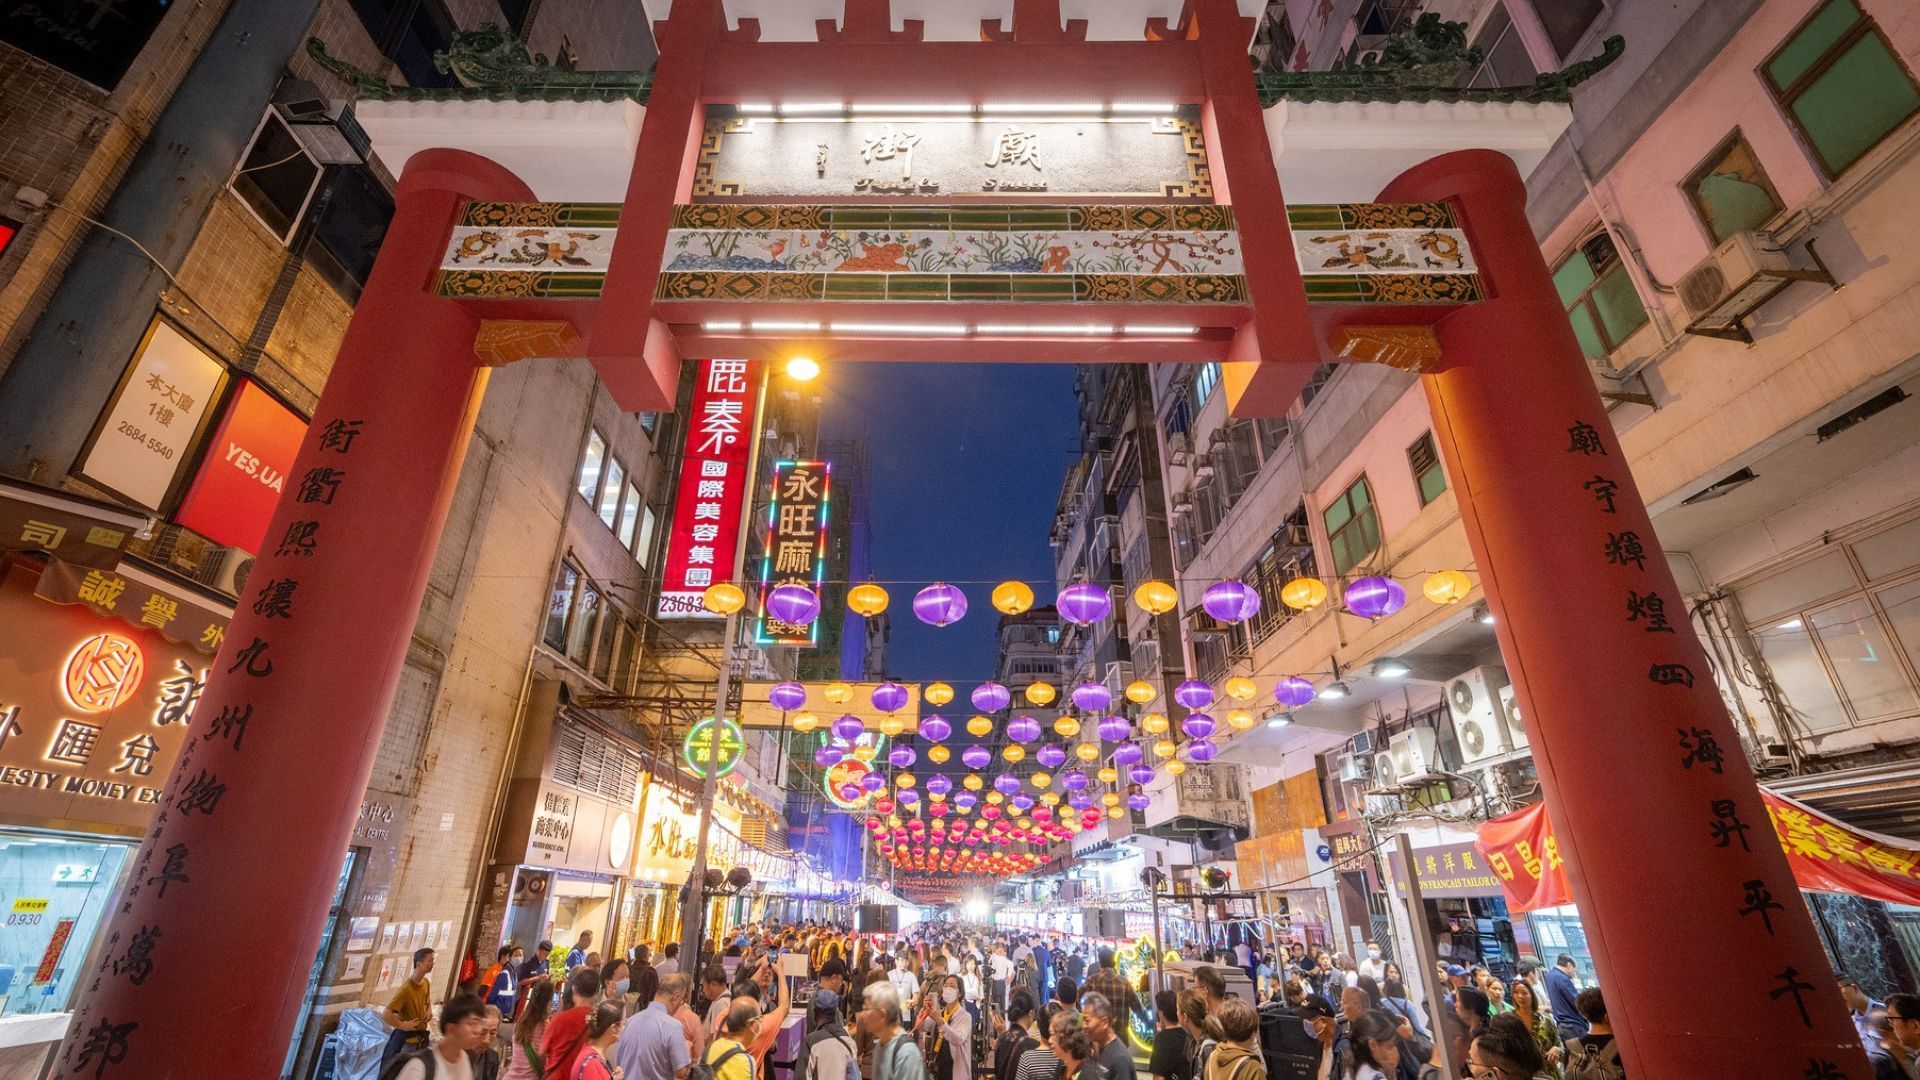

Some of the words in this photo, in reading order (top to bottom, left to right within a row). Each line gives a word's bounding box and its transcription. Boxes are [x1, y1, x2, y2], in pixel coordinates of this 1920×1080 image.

[982, 177, 1048, 192] Street
[145, 372, 196, 414] 本大廈
[148, 402, 175, 428] 1樓
[117, 420, 147, 445] 2684
[147, 437, 174, 461] 5540
[20, 519, 68, 549] 司
[658, 595, 707, 614] 23683
[0, 766, 61, 790] ESTY
[65, 776, 134, 800] MONEY
[7, 913, 42, 926] 0.930
